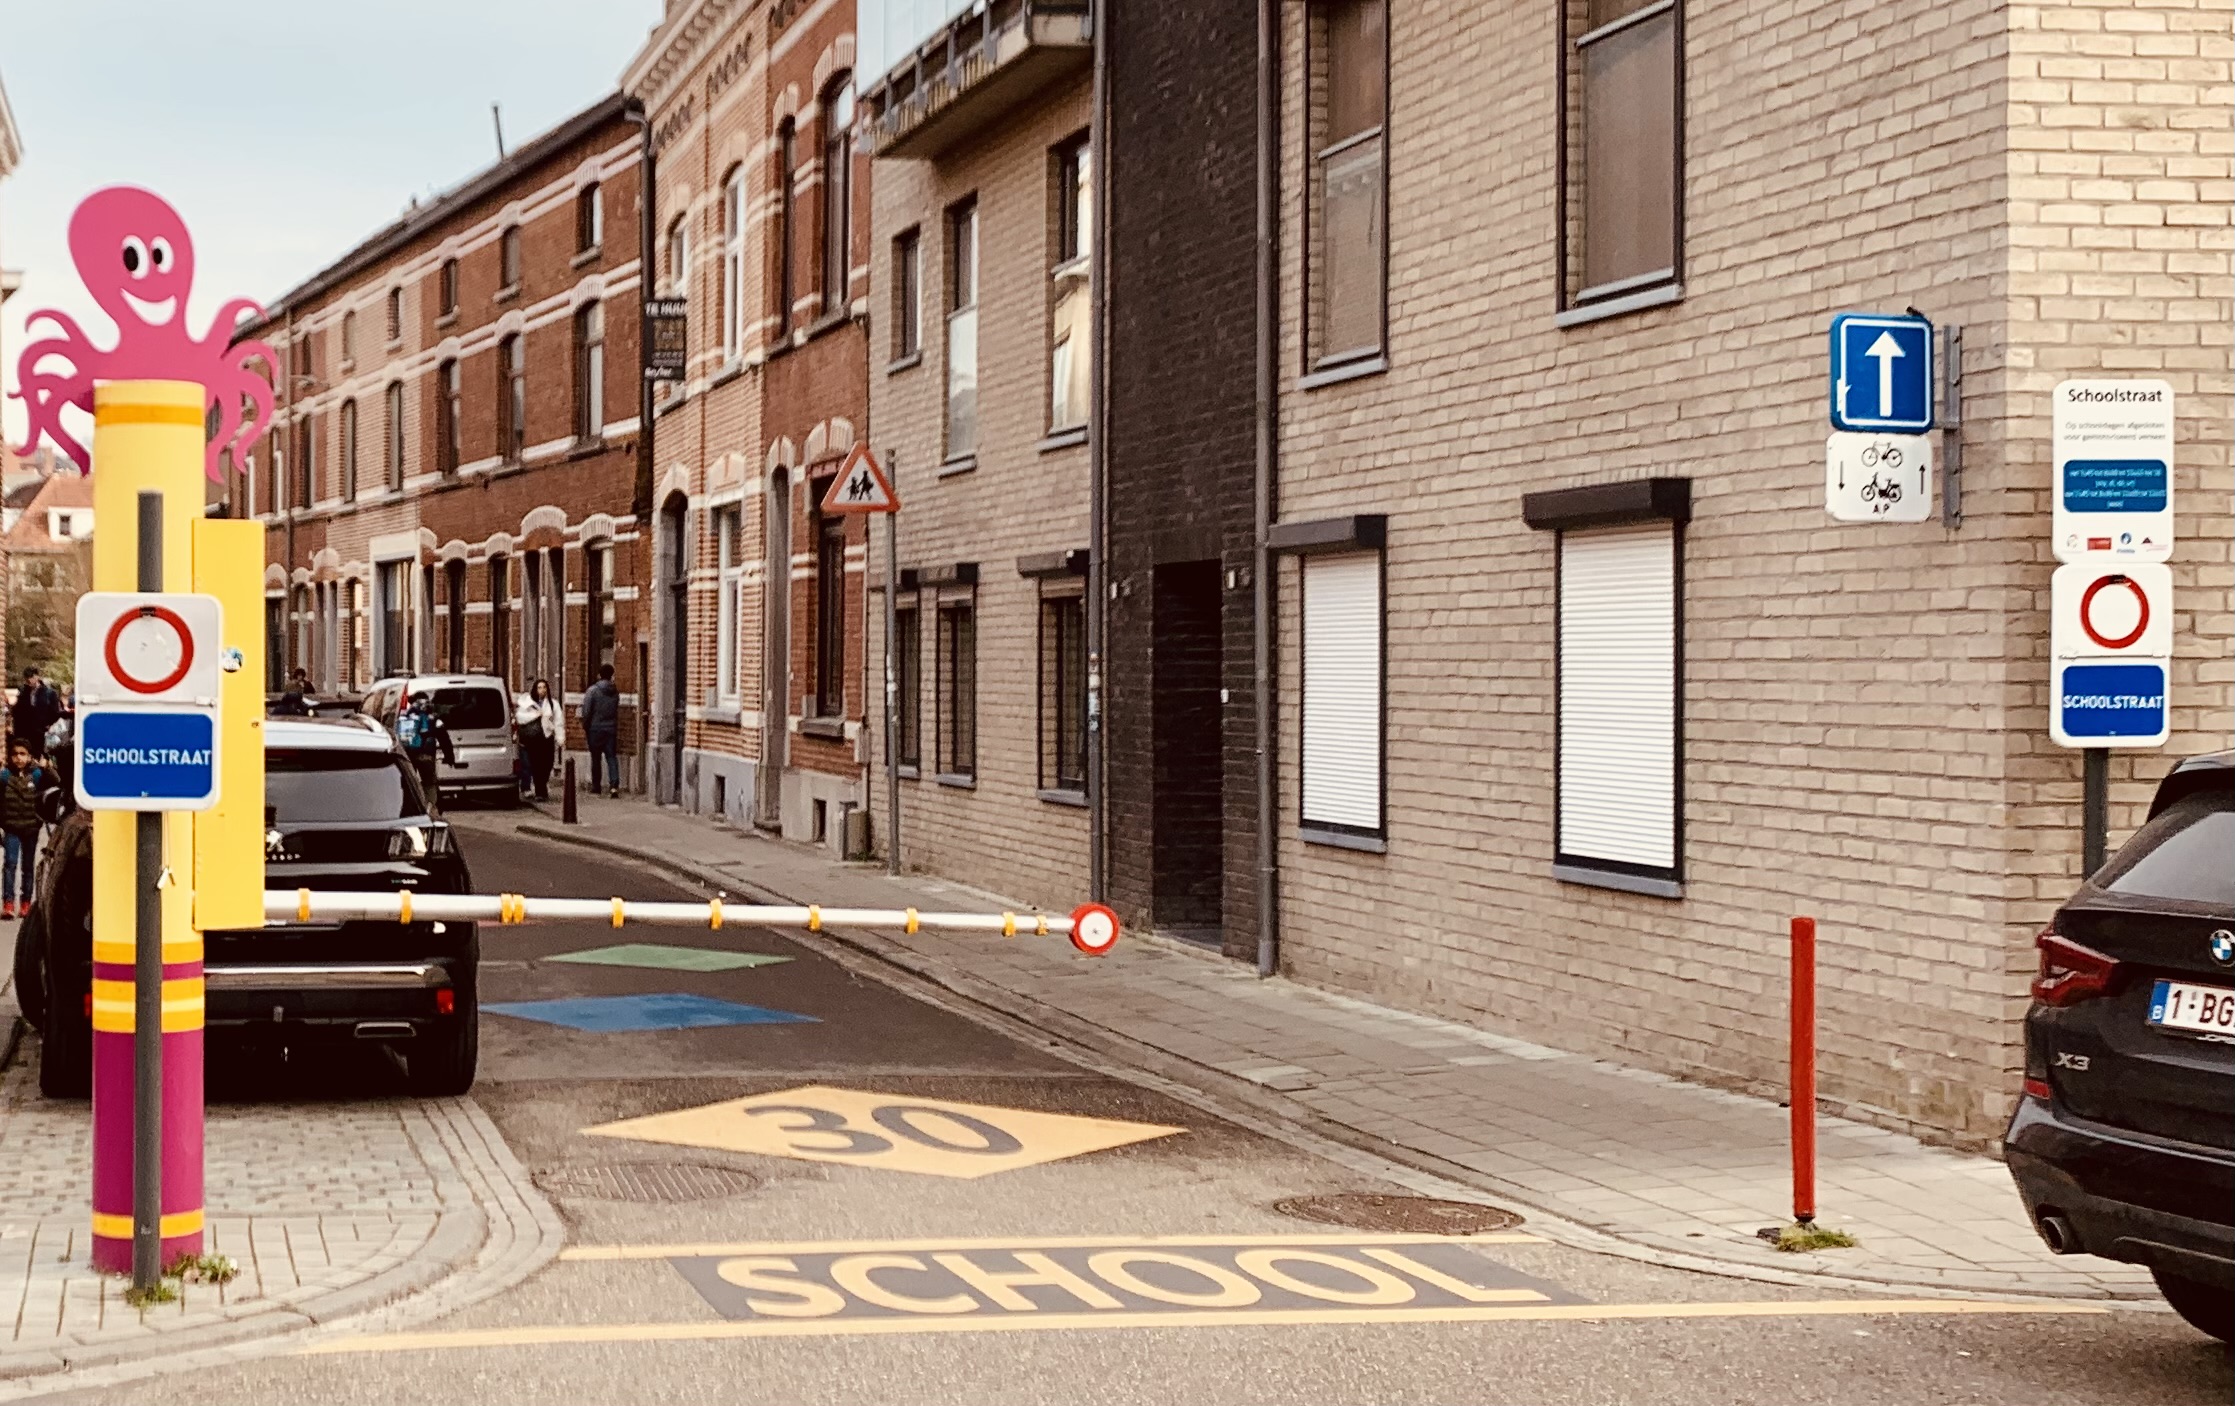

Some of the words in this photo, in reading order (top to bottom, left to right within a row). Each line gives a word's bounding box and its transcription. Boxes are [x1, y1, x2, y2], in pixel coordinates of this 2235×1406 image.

[2068, 388, 2162, 402] Schoolstraat
[1872, 504, 1881, 514] A
[1883, 504, 1890, 514] P
[2063, 695, 2163, 709] SCHOOLSTRAAT
[85, 748, 211, 765] SCHOOLSTRAAT
[2152, 1005, 2163, 1020] B
[2055, 1052, 2091, 1071] X3
[744, 1104, 1024, 1155] 30
[716, 1248, 1553, 1318] SCHOOL
